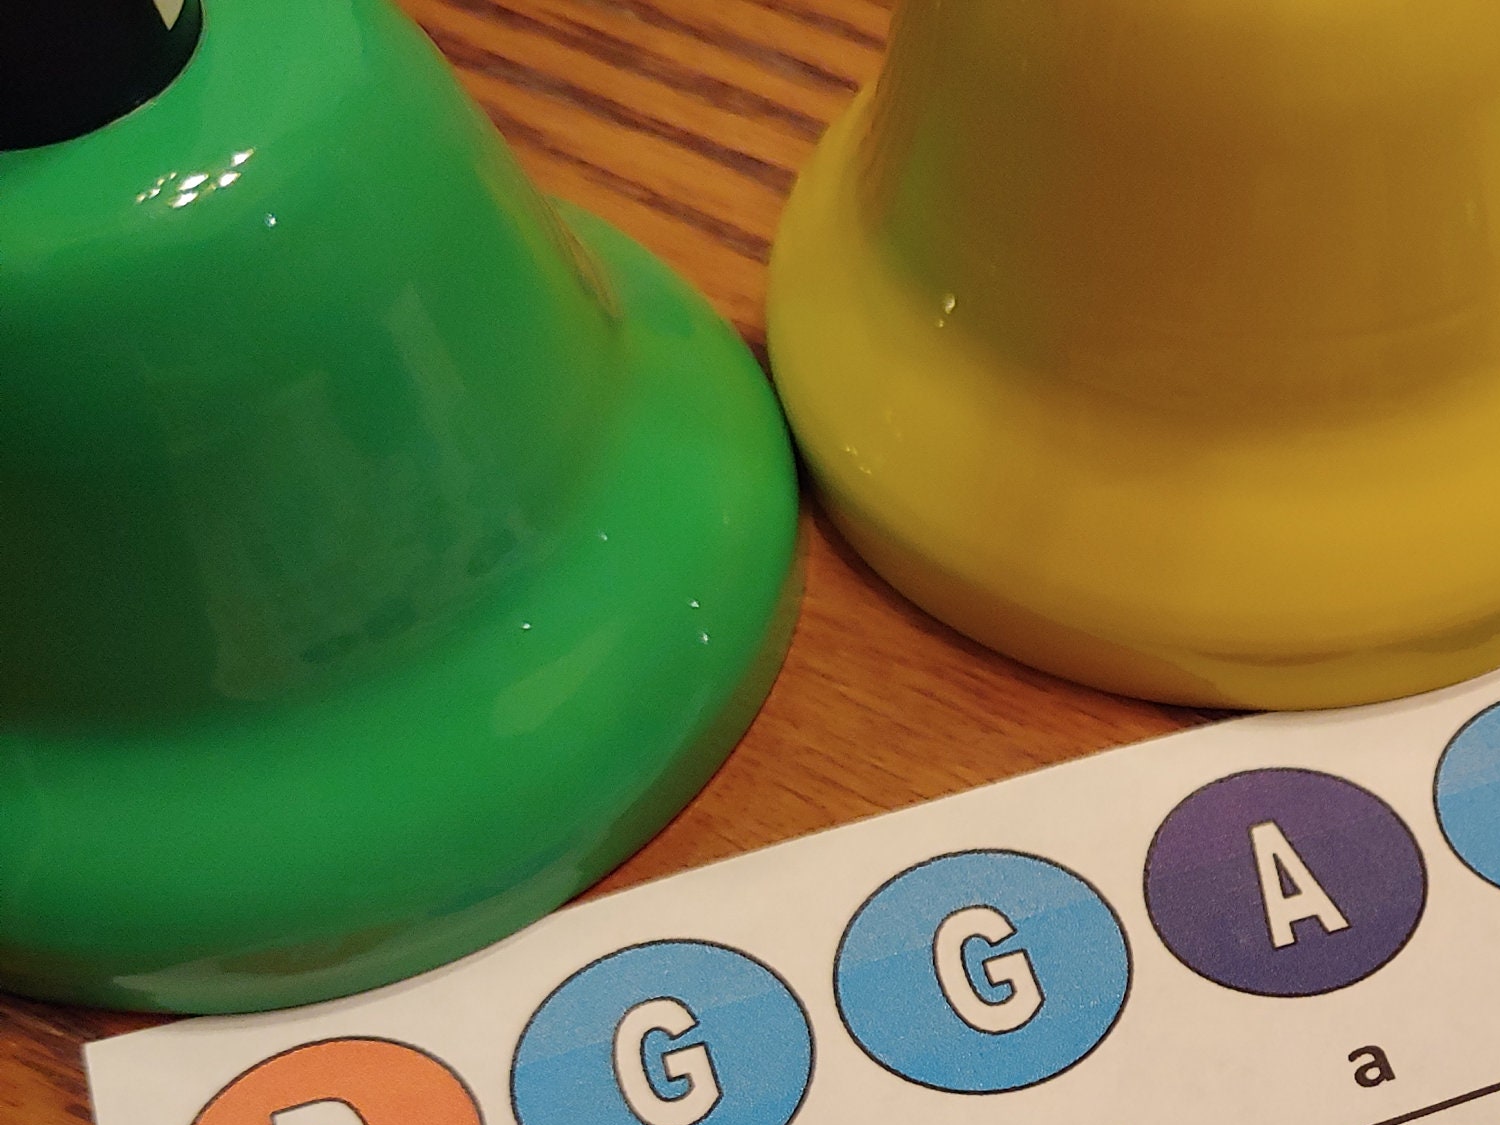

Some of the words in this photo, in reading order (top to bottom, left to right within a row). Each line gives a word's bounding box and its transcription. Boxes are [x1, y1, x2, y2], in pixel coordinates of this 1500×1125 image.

[931, 904, 1046, 1035] G
[1247, 820, 1351, 949] A
[1348, 1044, 1396, 1088] a
